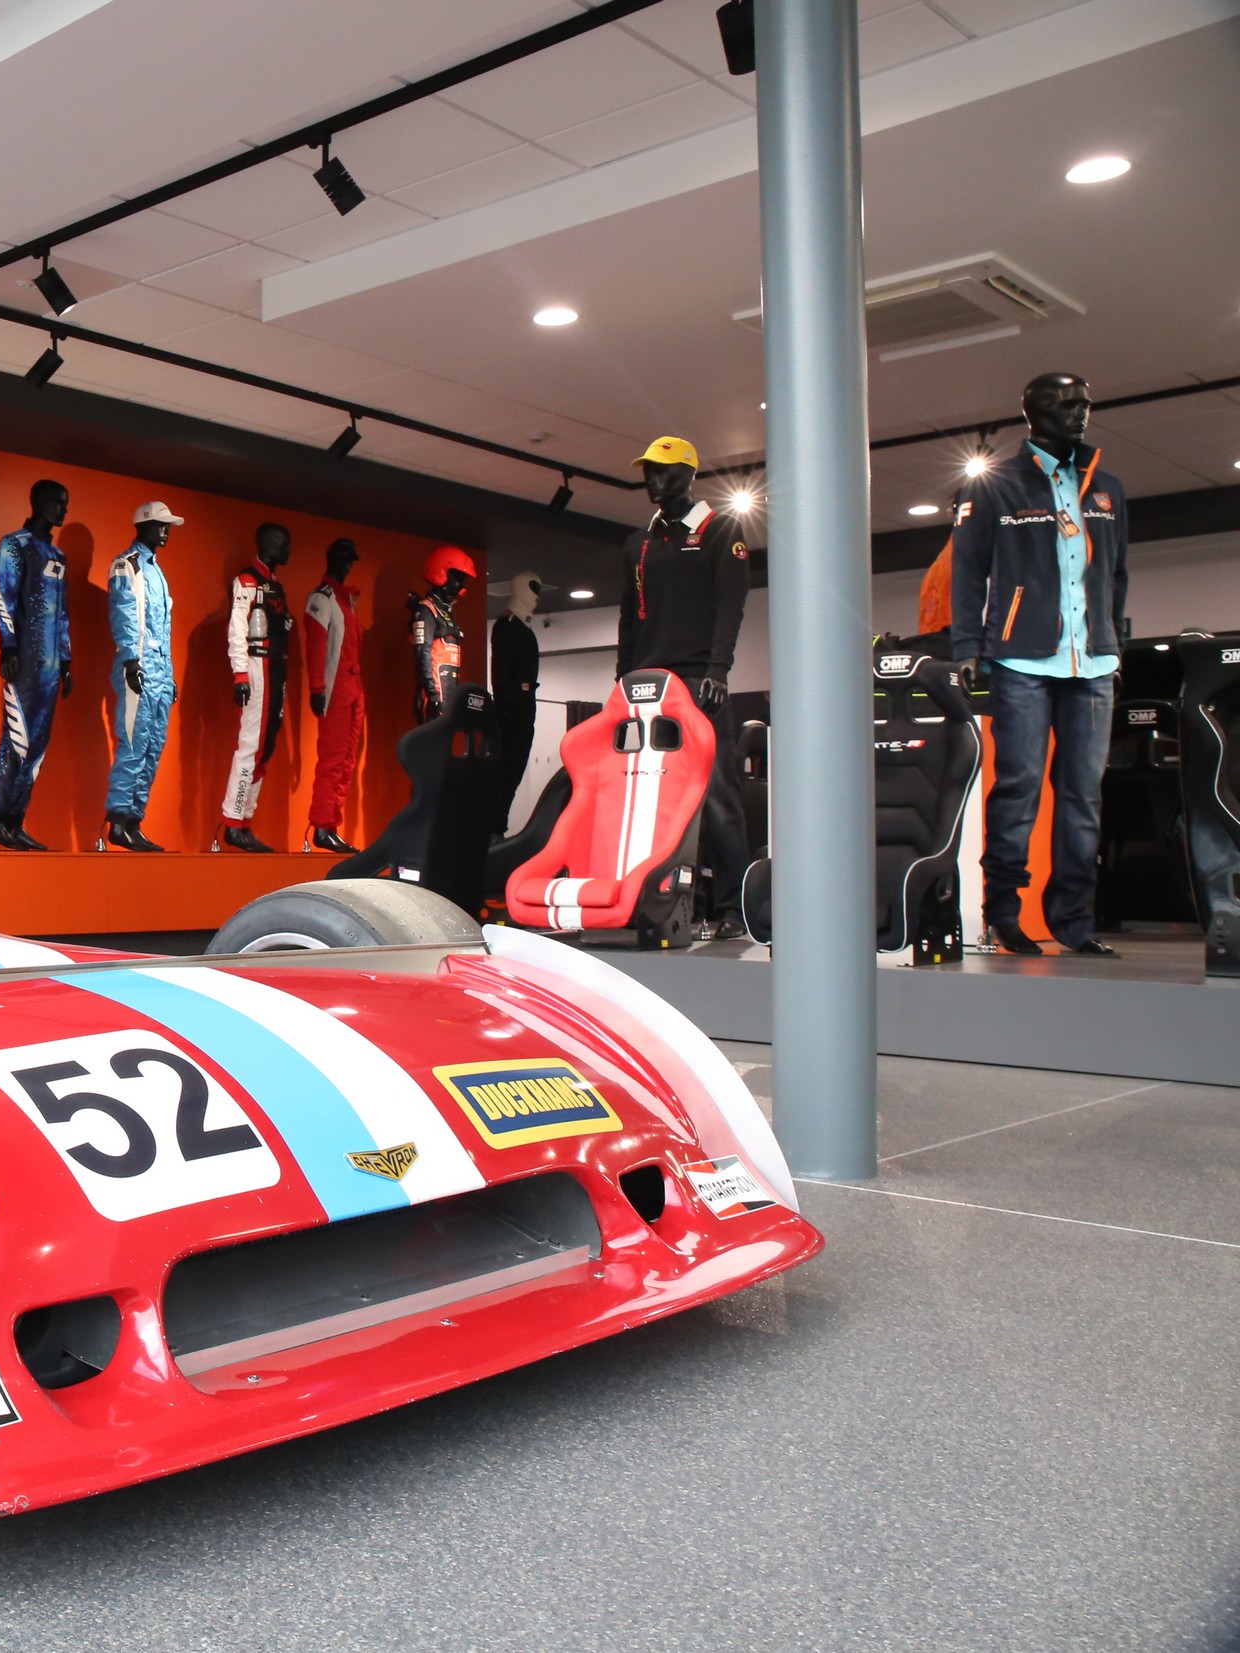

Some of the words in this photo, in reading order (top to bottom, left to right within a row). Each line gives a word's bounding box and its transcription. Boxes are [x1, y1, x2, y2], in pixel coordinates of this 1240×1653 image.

[1221, 650, 1240, 661] OM
[880, 658, 911, 670] OMP
[632, 687, 656, 697] OMP
[467, 696, 484, 708] OMP
[1128, 711, 1157, 721] OMP
[466, 1076, 594, 1121] DUCKHAMS
[10, 1048, 263, 1178] 52
[352, 1145, 417, 1178] CHEVRON
